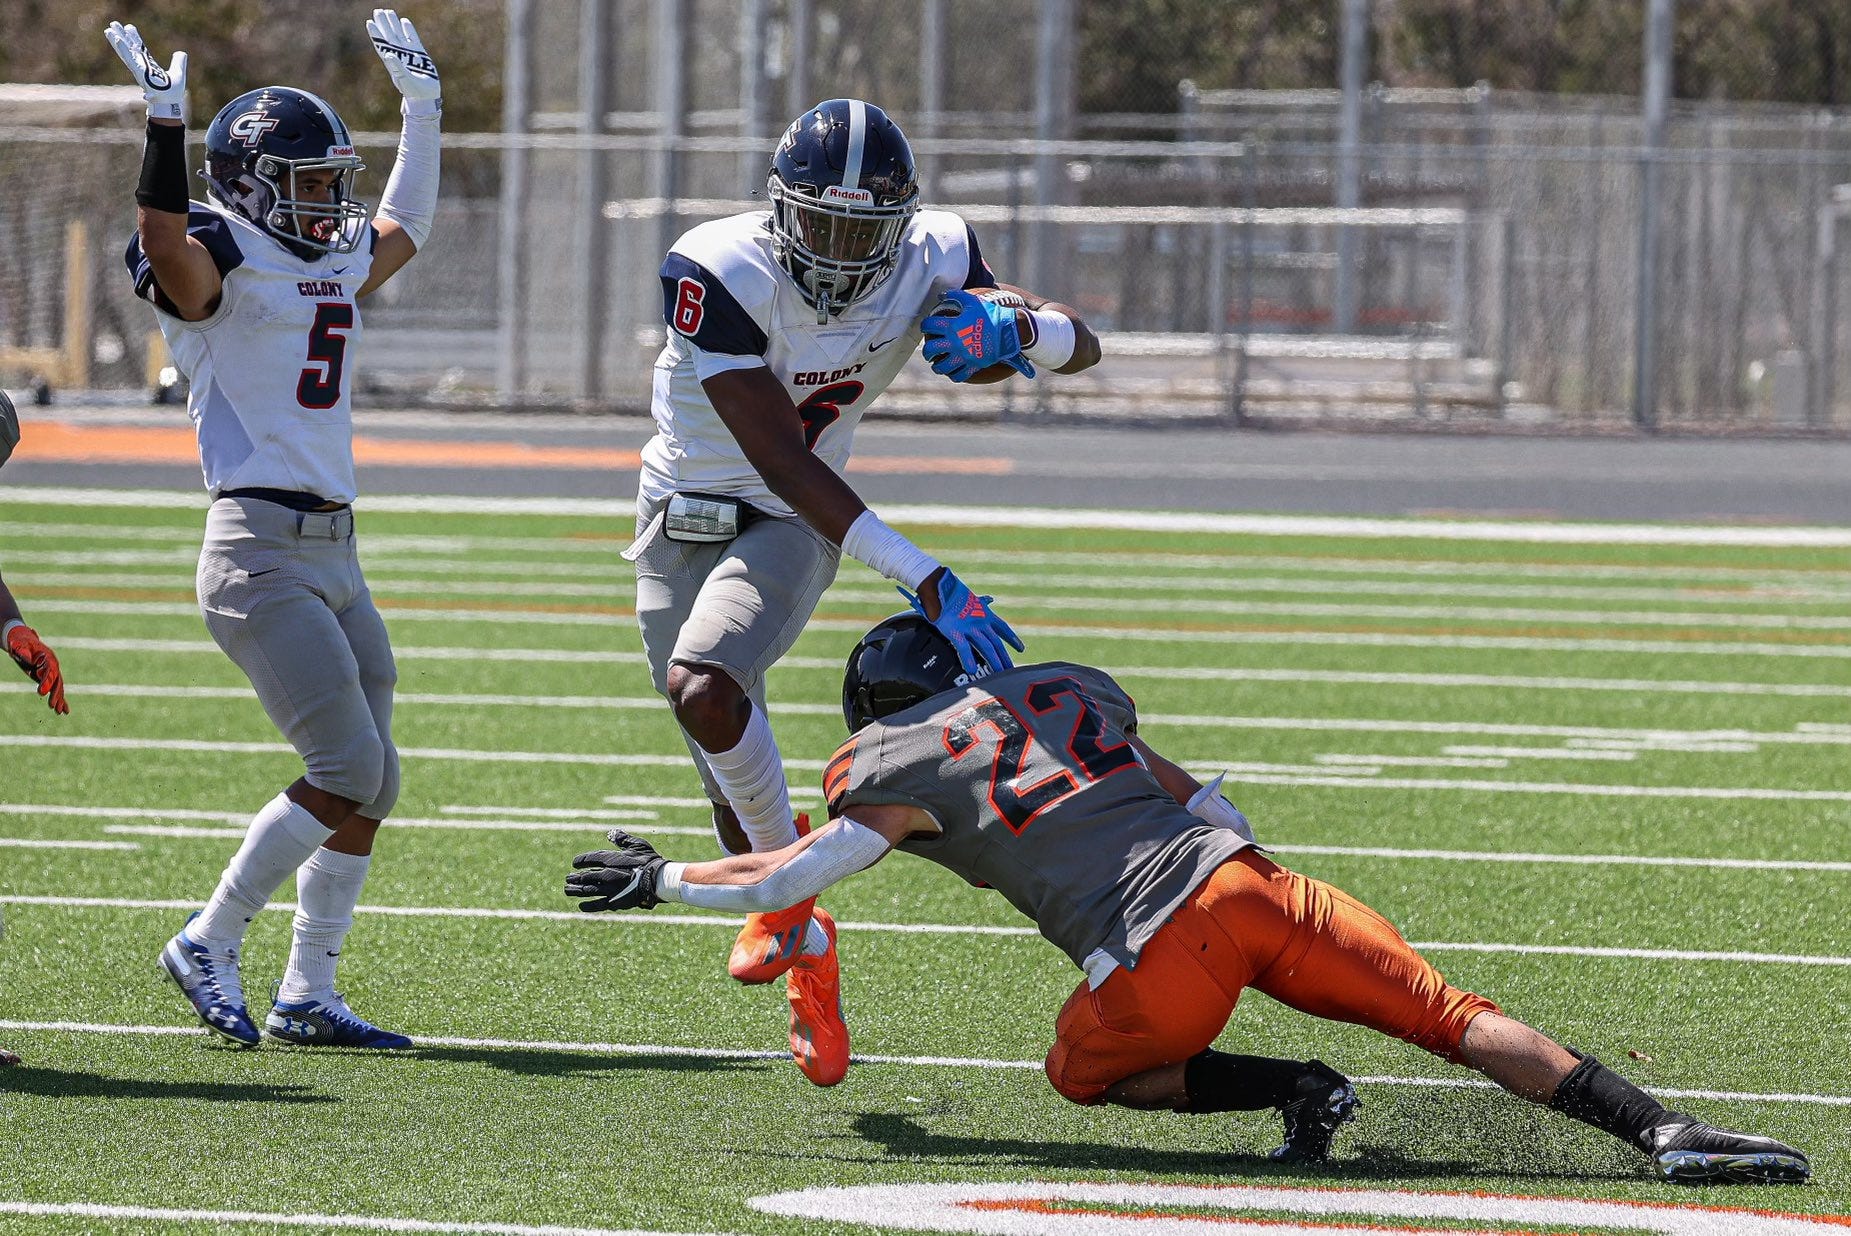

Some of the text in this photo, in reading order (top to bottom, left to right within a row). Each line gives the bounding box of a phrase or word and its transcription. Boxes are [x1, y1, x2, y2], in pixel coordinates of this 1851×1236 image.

[829, 188, 869, 201] Riddell
[297, 282, 344, 298] COLONY
[673, 277, 706, 336] 6
[296, 302, 353, 410] 5
[973, 318, 984, 359] adidas
[793, 362, 867, 386] COLONY
[942, 676, 1140, 838] 22
